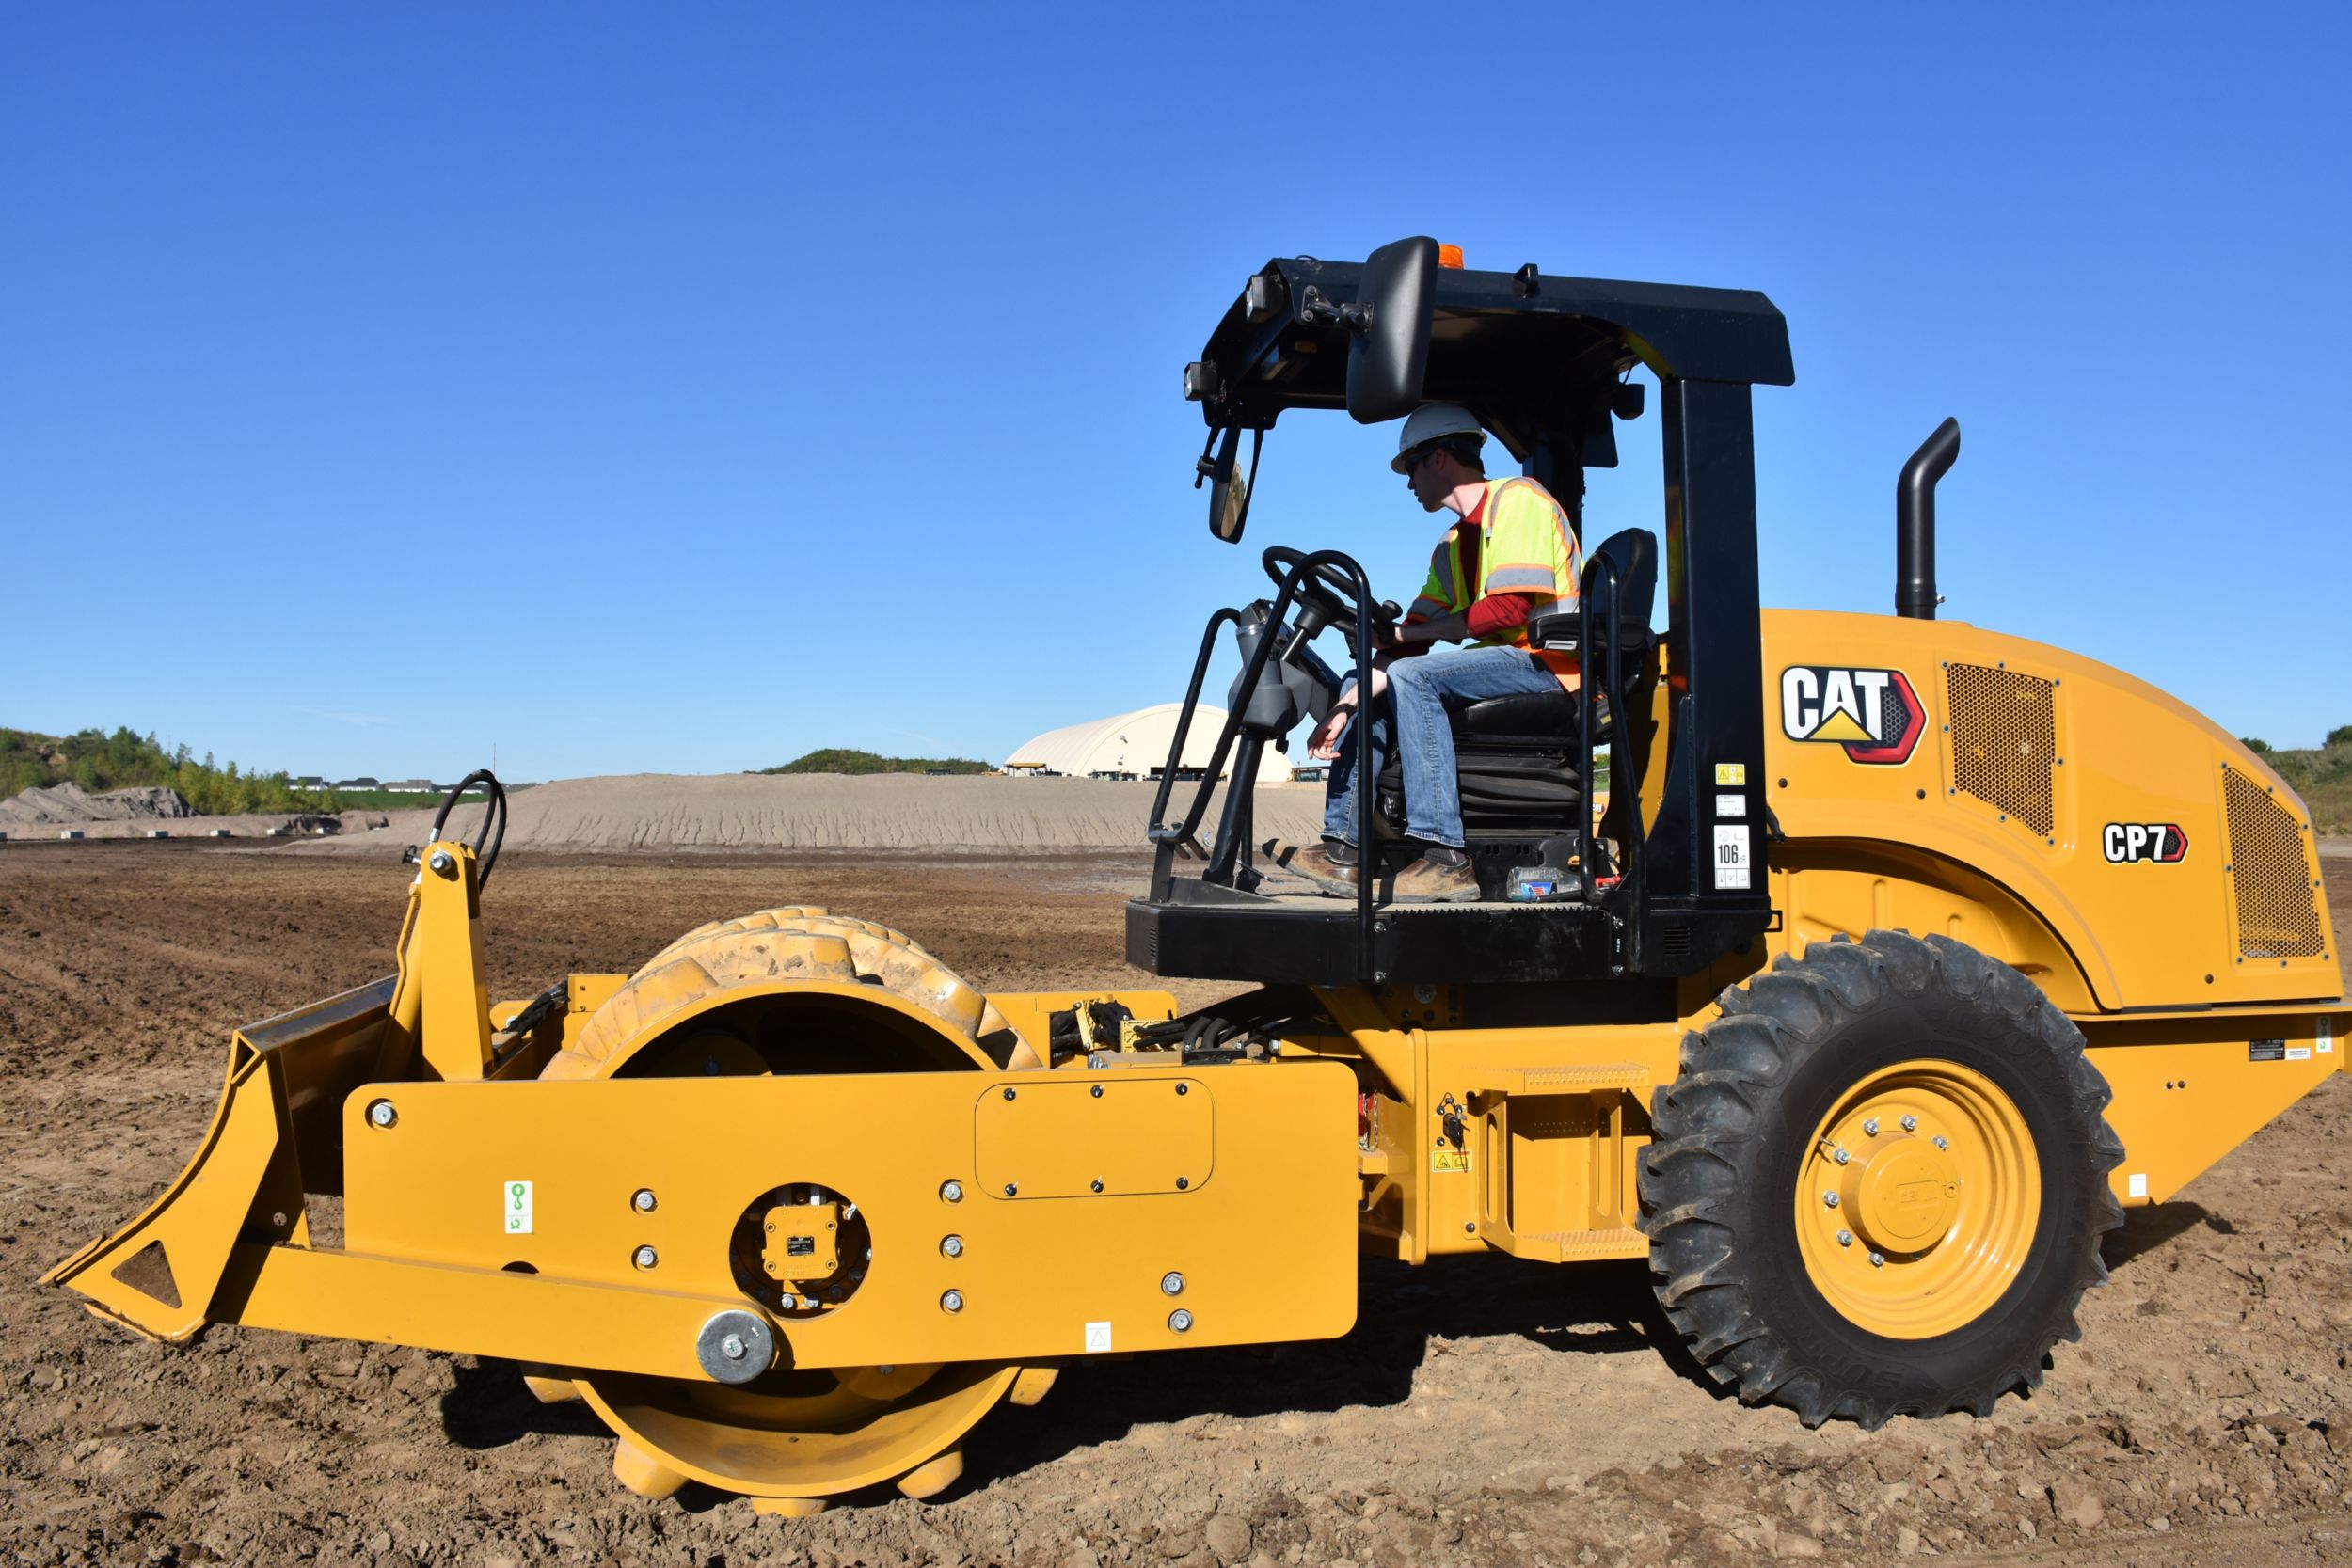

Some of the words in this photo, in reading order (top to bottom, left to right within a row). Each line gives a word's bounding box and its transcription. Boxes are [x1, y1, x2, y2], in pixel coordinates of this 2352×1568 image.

[1782, 667, 1889, 741] CAT
[1717, 844, 1739, 864] 106
[2104, 824, 2167, 862] CP7
